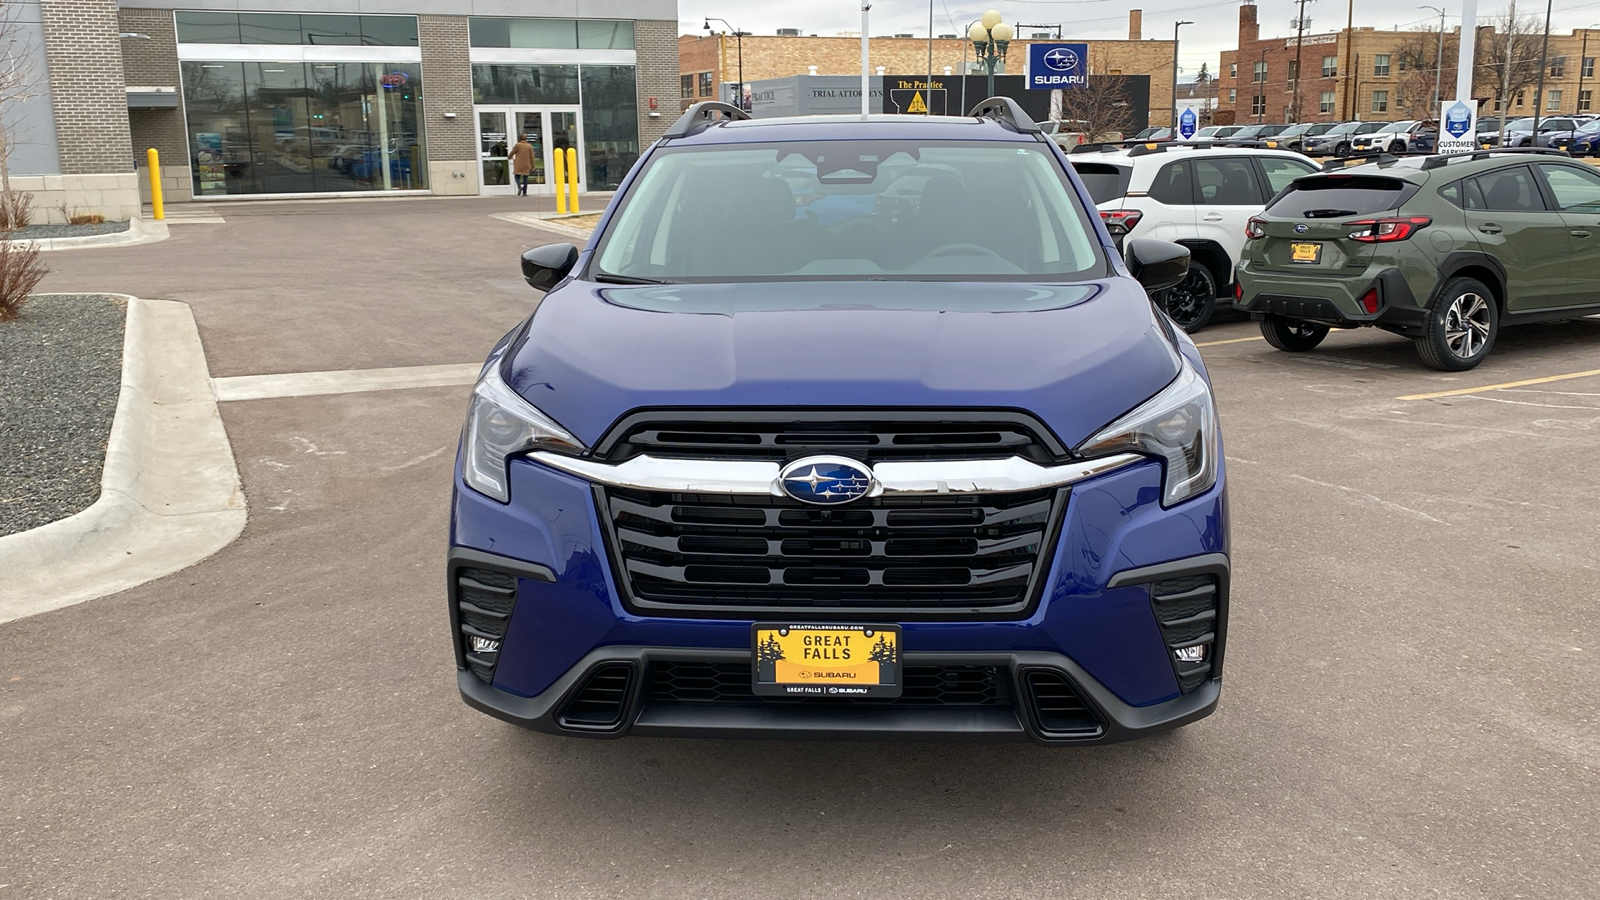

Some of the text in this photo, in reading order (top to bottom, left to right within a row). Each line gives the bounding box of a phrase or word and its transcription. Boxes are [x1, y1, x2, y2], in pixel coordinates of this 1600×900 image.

[897, 80, 943, 88] The Pratice
[1034, 75, 1084, 84] SUBARU
[752, 91, 775, 102] PRACTICE
[804, 636, 850, 646] GREAT
[804, 648, 851, 660] FALLS
